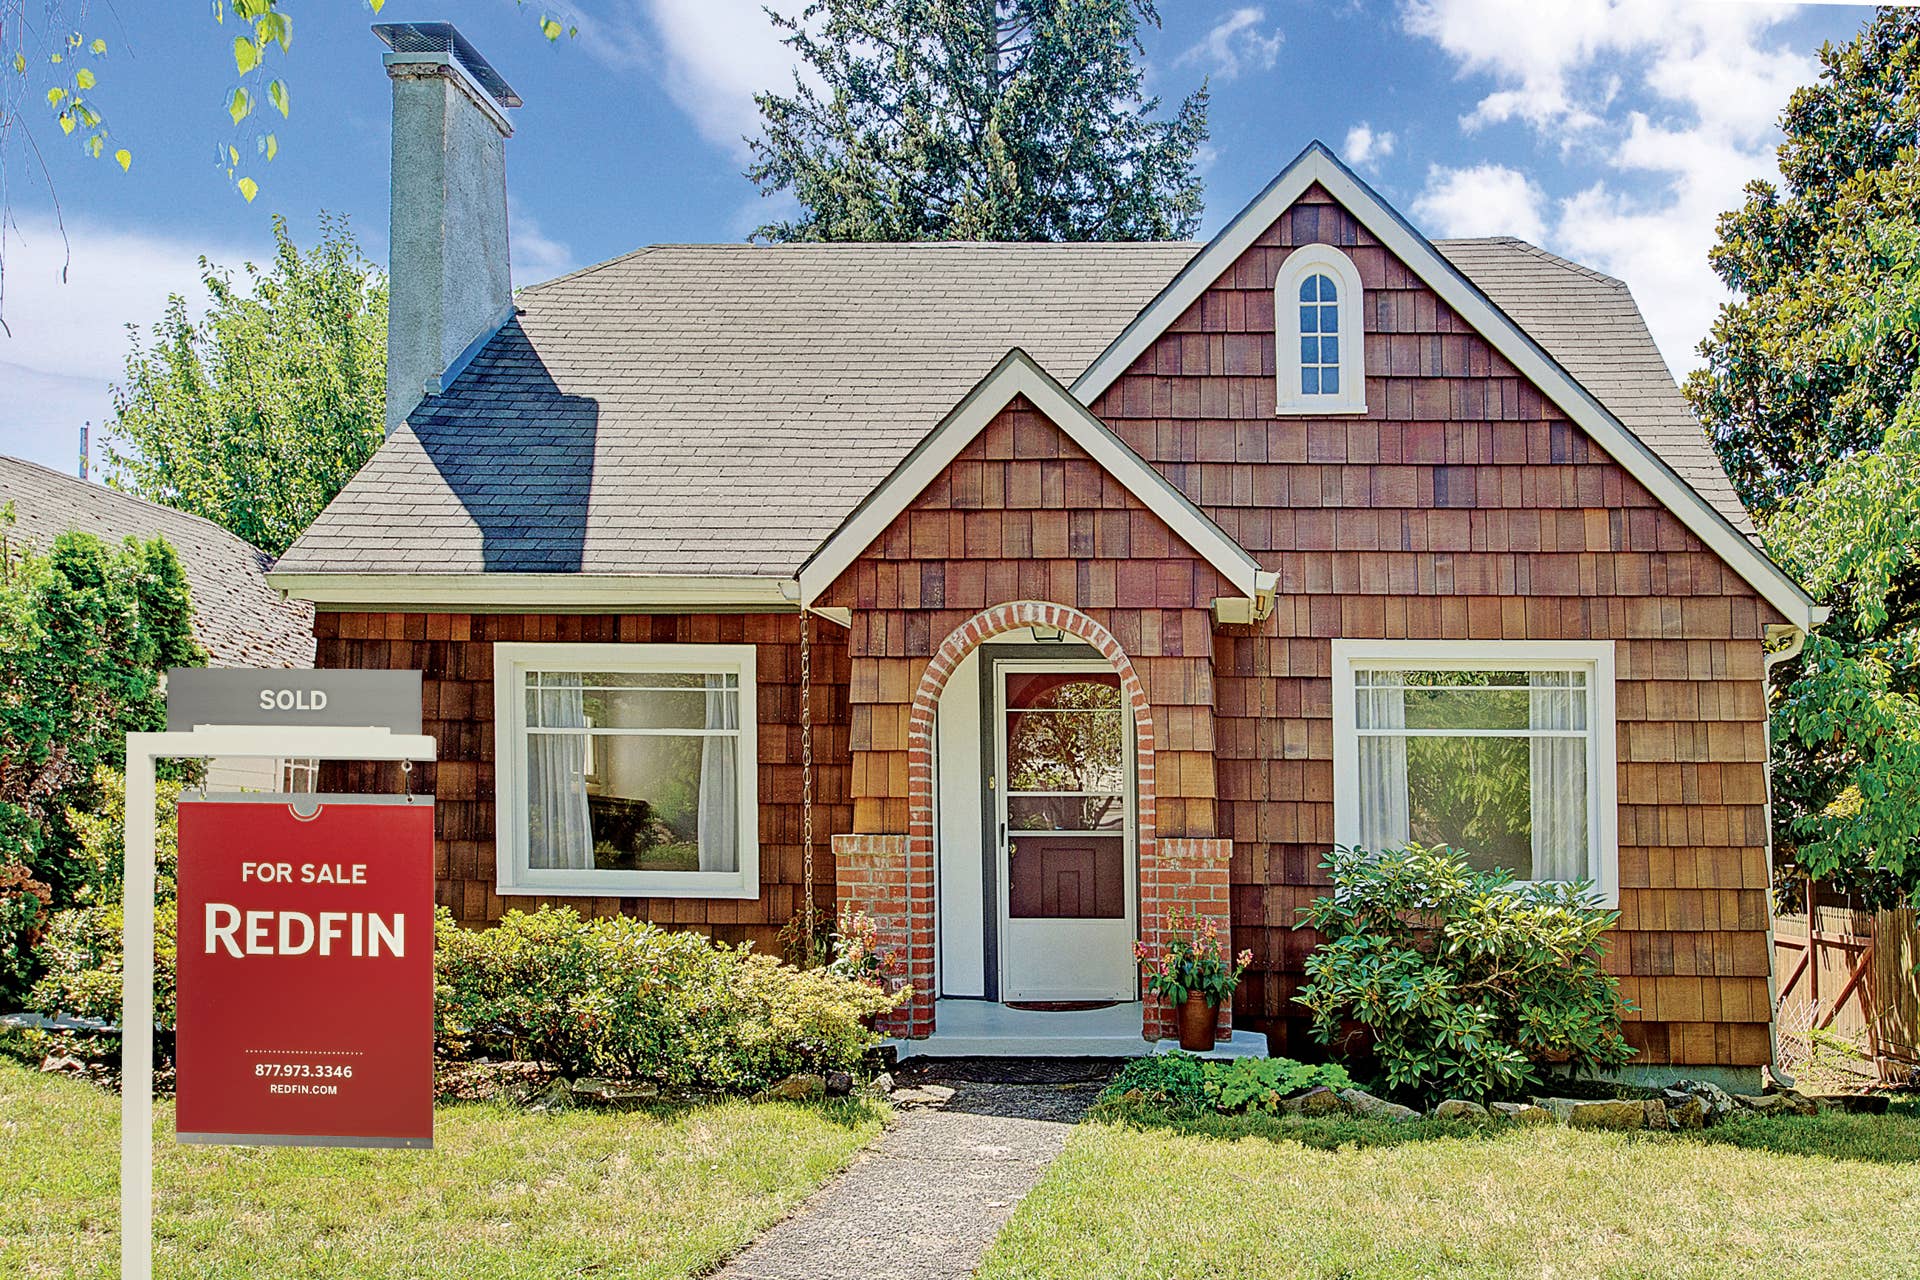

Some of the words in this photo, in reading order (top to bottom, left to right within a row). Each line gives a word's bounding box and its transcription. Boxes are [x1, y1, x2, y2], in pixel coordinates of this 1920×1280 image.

[260, 689, 327, 710] SOLD
[242, 862, 293, 883] FOR
[300, 863, 367, 885] SALE
[204, 903, 405, 959] REDFIN
[254, 1063, 353, 1079] 877.973.3346
[269, 1084, 338, 1095] REDFIN.COM
